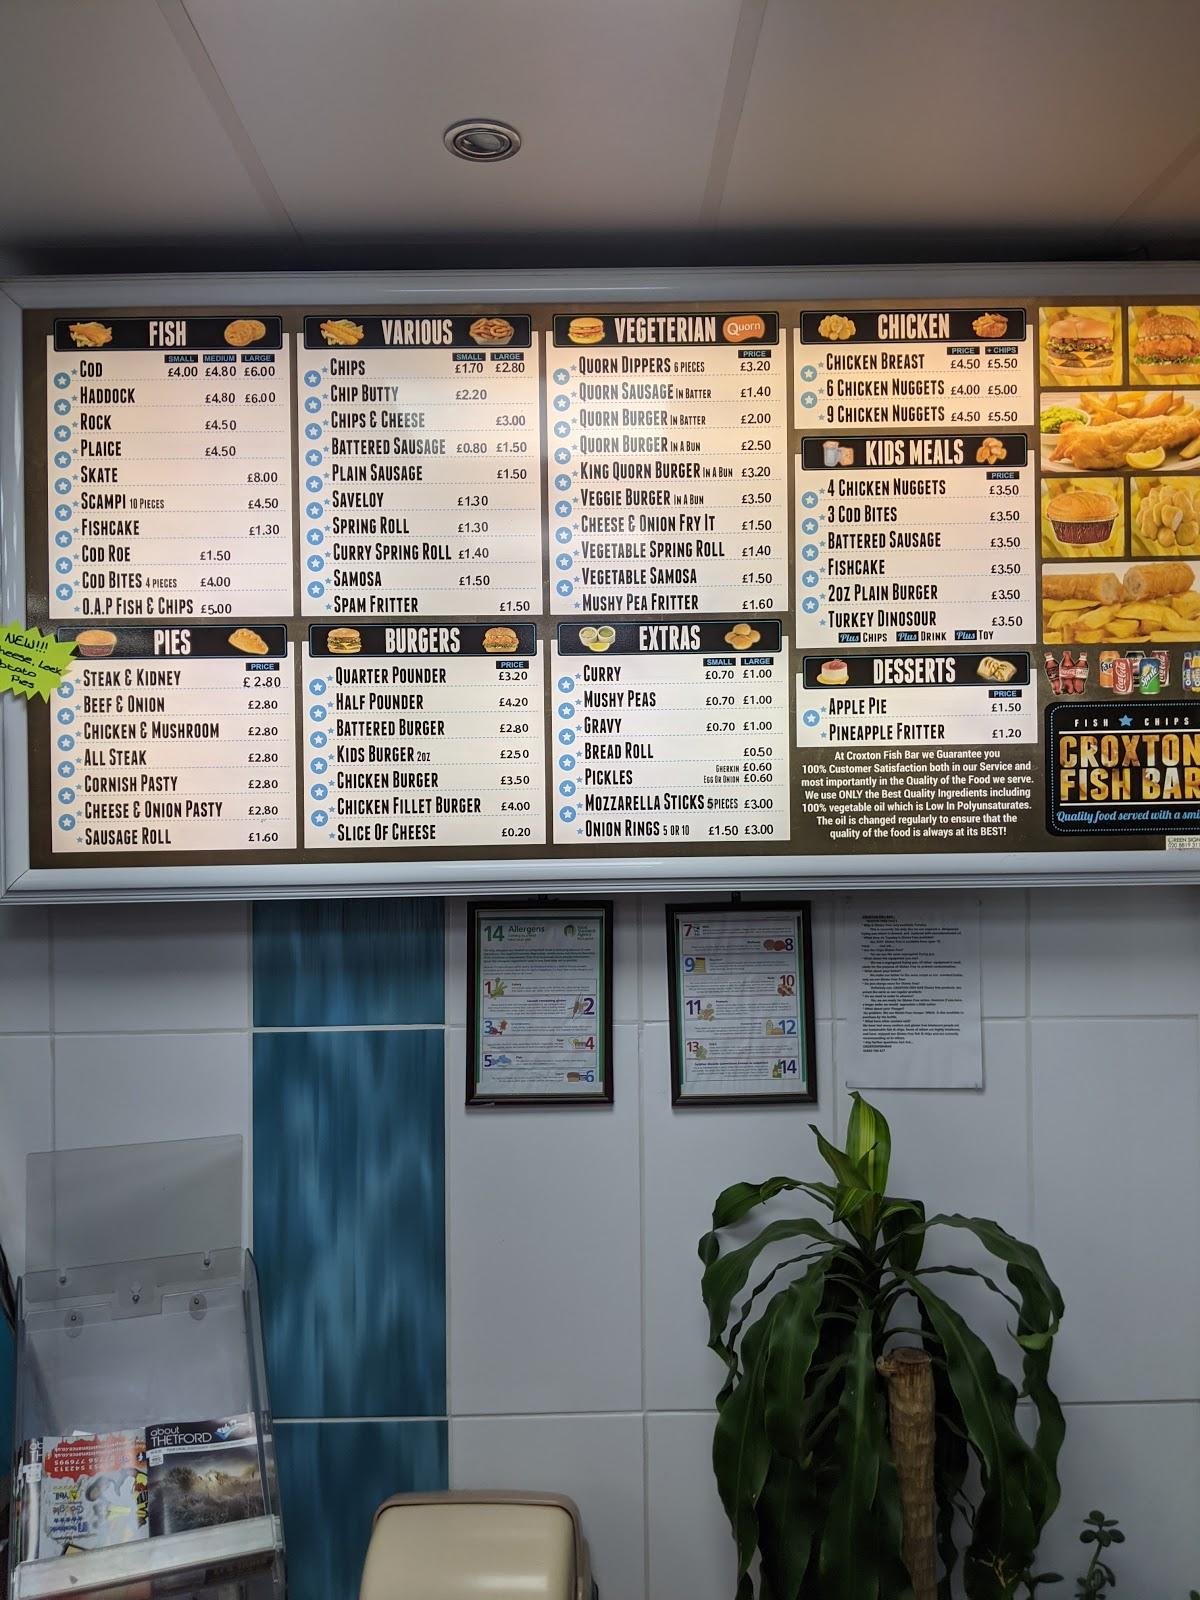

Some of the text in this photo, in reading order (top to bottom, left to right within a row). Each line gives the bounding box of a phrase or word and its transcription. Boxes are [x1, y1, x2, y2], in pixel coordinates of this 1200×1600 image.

[381, 320, 453, 345] VARIOUS
[614, 317, 716, 343] VEGETERIAN
[726, 319, 761, 335] Quorn
[877, 313, 950, 340] CHICKEN
[149, 320, 187, 347] FISH
[993, 346, 1017, 354] CHIPS
[244, 354, 272, 362] LARGE
[456, 353, 482, 361] SMALL
[950, 359, 980, 369] £4.50
[987, 358, 1018, 368] £5.50
[167, 366, 199, 378] £4.00
[205, 366, 237, 377] £4.80
[243, 366, 276, 377] £6.00
[455, 363, 484, 374] £1.70
[495, 362, 525, 373] £2.80
[674, 362, 679, 373] 6
[740, 361, 771, 372] £3.20
[456, 443, 487, 454] £0.80
[496, 442, 527, 453] £1.50
[865, 438, 964, 466] KIDS MEALS
[129, 499, 138, 509] 10
[247, 498, 279, 509] £4.50
[683, 495, 688, 505] A
[741, 493, 772, 504] £3.50
[828, 505, 834, 522] 3
[989, 511, 1020, 521] £3.50
[146, 597, 155, 614] &
[200, 603, 232, 614] £5.00
[4, 632, 48, 653] NEW!!!
[153, 629, 191, 655] PIES
[385, 627, 460, 653] BURGERS
[639, 625, 701, 651] EXTRAS
[839, 633, 860, 642] Plus
[897, 632, 918, 641] Plus
[955, 630, 976, 640] Plus
[706, 658, 733, 666] SMALL
[498, 671, 528, 681] £3.20
[705, 670, 735, 680] £0.70
[742, 669, 772, 679] £1.00
[873, 658, 956, 684] DESSERTS
[116, 695, 123, 713] &
[248, 700, 278, 710] £2.80
[991, 703, 1022, 712] £1.50
[1074, 717, 1189, 727] FISH CHIPS
[834, 751, 845, 761] At
[846, 751, 881, 760] Croxton
[883, 750, 902, 760] Fish
[904, 750, 920, 759] Bar
[936, 750, 982, 759] Guarantee
[984, 751, 1000, 760] you
[1060, 734, 1200, 768] CROXTON
[742, 762, 772, 772] £0.60
[1060, 767, 1200, 801] FISH BAR
[1056, 810, 1200, 824] Quality food served with a smi
[248, 832, 279, 843] £1.60
[501, 828, 531, 837] £0.20
[830, 826, 1007, 840] quality of the food is always at its BEST!
[483, 925, 504, 941] 14
[508, 924, 545, 934] Allergens
[683, 924, 693, 936] 7
[785, 938, 794, 951] 8
[684, 957, 695, 972] 9
[484, 981, 491, 994] 1
[780, 975, 795, 987] 10
[583, 998, 595, 1015] 2
[686, 1000, 700, 1015] 11
[484, 1021, 493, 1034] 3
[778, 1020, 796, 1035] 12
[585, 1036, 594, 1049] 4
[686, 1042, 699, 1052] 13
[484, 1054, 492, 1067] 5
[780, 1060, 797, 1074] 14
[586, 1070, 594, 1083] 6
[150, 1426, 180, 1437] about
[150, 1432, 212, 1447] THETFORD
